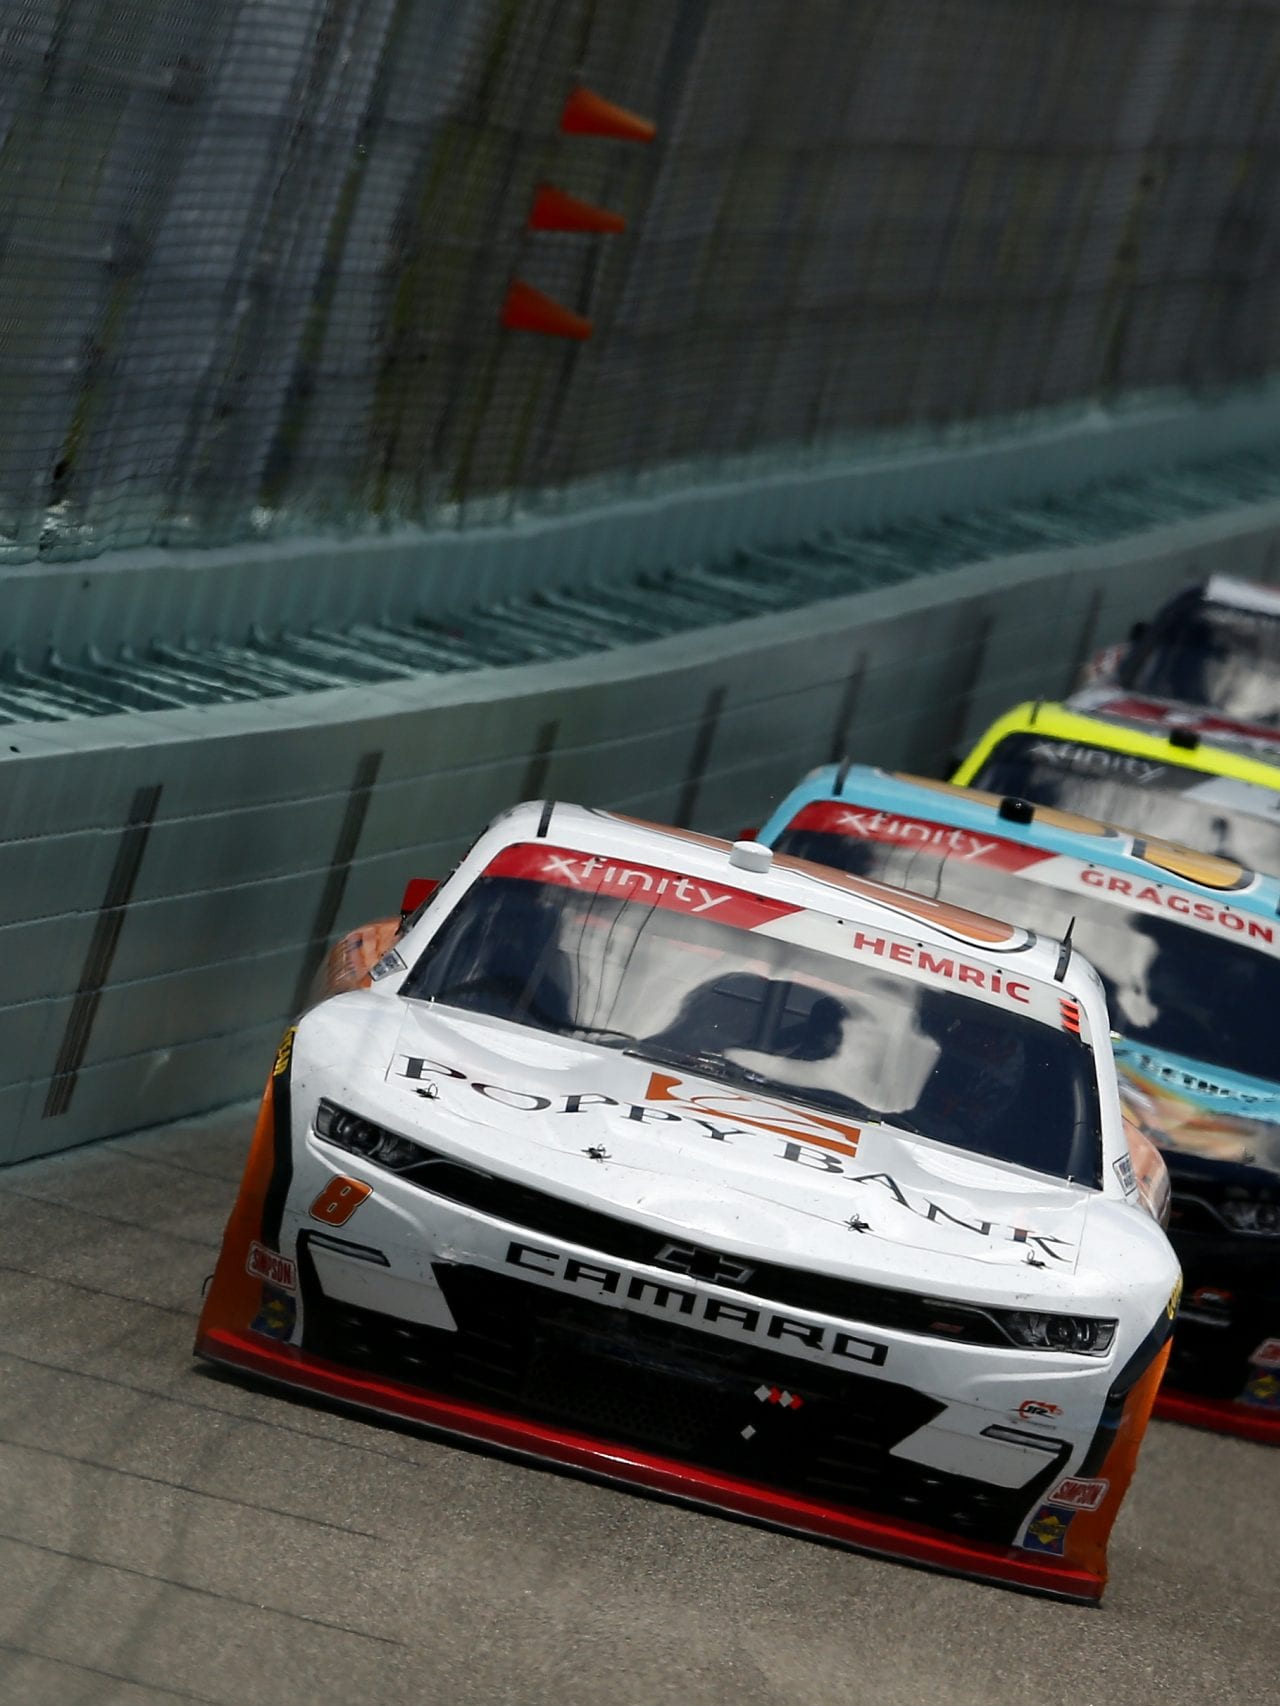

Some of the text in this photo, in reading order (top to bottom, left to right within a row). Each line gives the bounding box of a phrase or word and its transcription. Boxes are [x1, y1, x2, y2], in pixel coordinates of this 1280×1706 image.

[836, 809, 1000, 861] xfinity
[541, 853, 733, 913] xfinity
[1080, 868, 1275, 945] GRAGSON
[853, 931, 1031, 1004] HEMRIC
[397, 1054, 1077, 1264] POPPY BANK
[308, 1174, 374, 1227] 8
[505, 1241, 889, 1367] CAMARO
